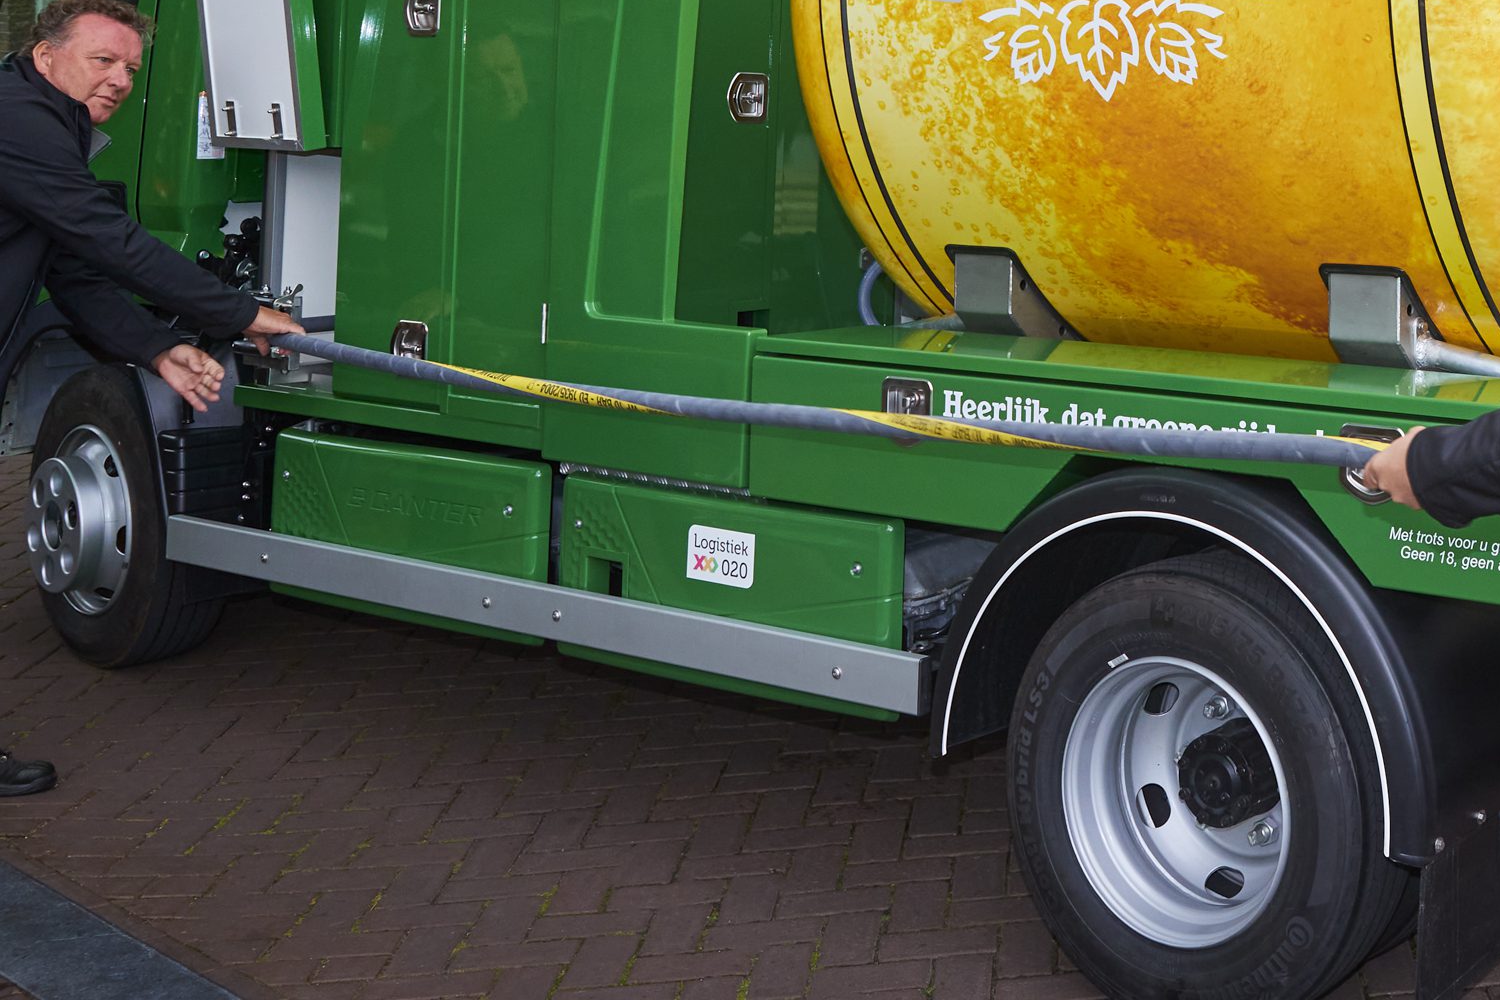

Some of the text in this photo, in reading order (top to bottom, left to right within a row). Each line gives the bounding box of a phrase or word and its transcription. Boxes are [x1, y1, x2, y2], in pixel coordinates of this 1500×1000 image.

[1061, 403, 1107, 427] dat
[693, 532, 749, 557] Logistiek
[1388, 526, 1413, 543] Met
[1415, 529, 1445, 546] trots
[1447, 535, 1478, 551] voor
[1479, 541, 1489, 552] u
[721, 559, 748, 579] 020
[1399, 545, 1435, 562] Geen
[1438, 550, 1458, 568] 18,
[1461, 555, 1495, 571] geen
[1022, 670, 1051, 726] LS3
